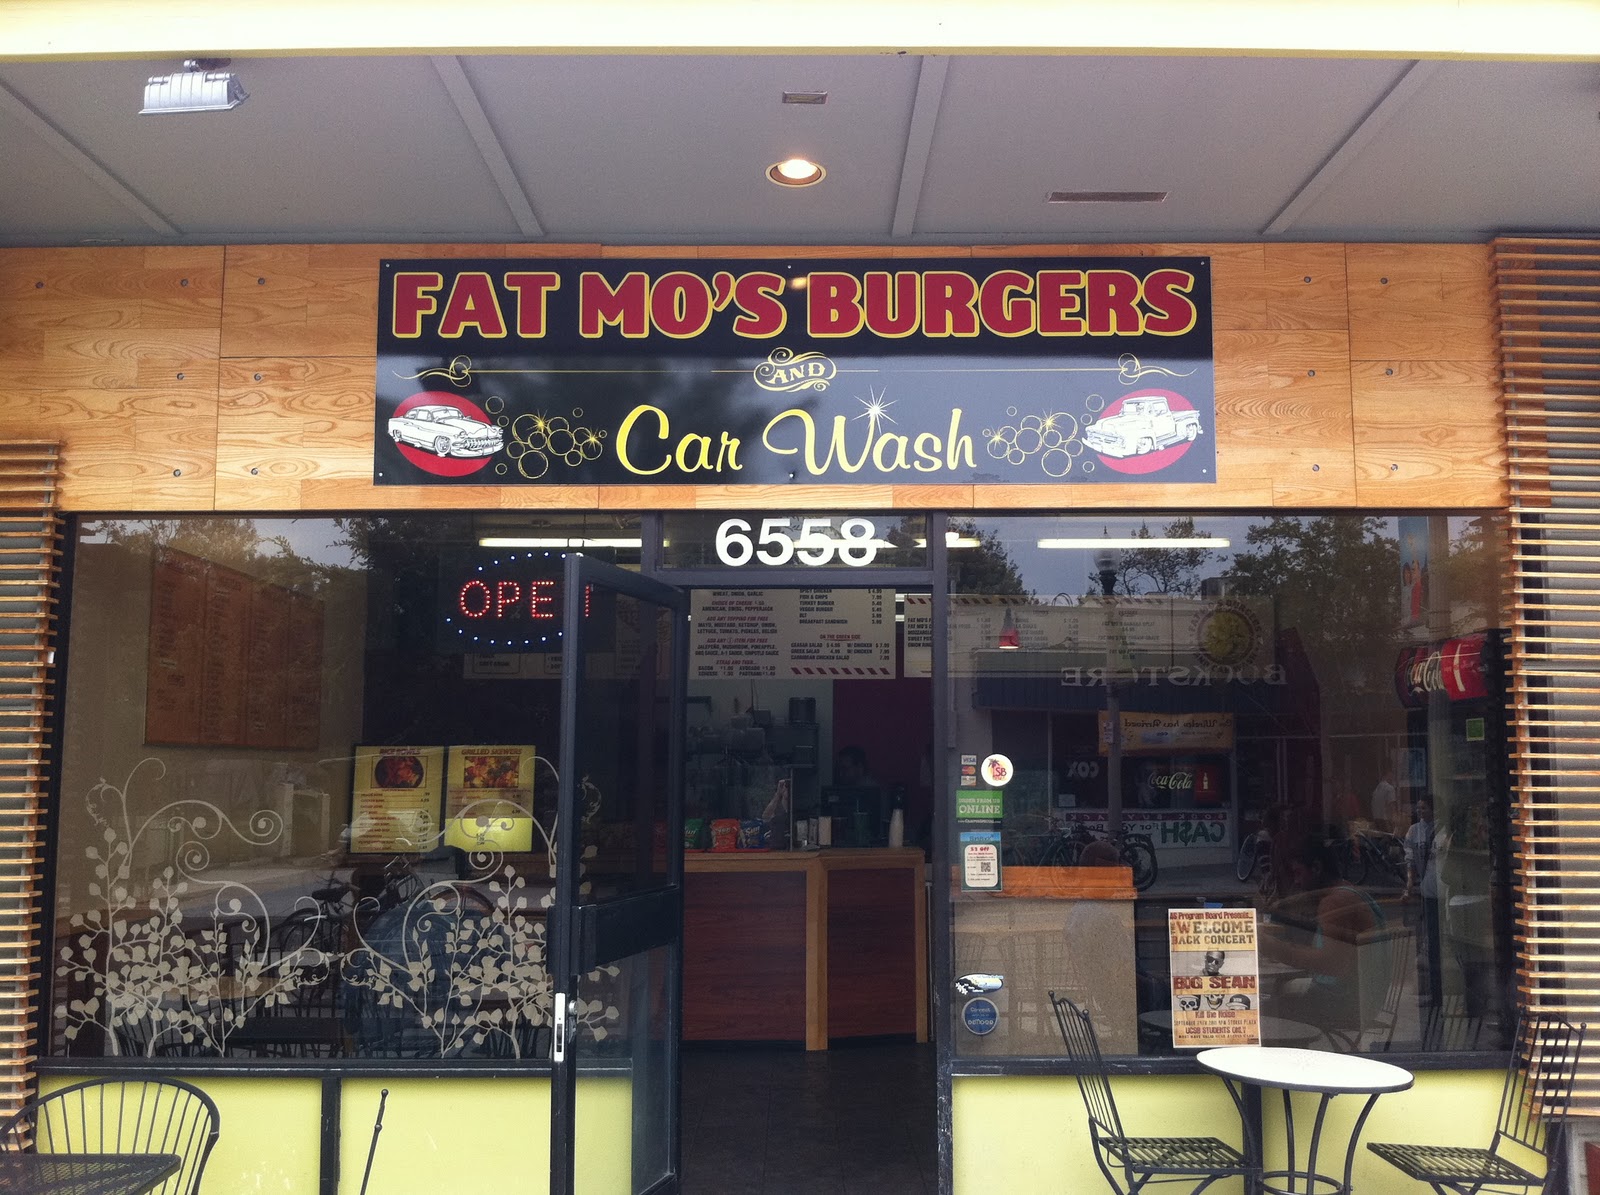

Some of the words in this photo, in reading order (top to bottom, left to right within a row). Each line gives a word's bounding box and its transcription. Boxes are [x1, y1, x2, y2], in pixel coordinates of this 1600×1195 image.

[392, 271, 561, 339] FAT
[578, 271, 786, 339] MO'S
[807, 270, 1198, 338] BURGERS
[768, 362, 826, 383] AND
[616, 405, 742, 475] Car
[763, 407, 977, 474] Wash
[715, 518, 878, 567] 6558
[959, 805, 1000, 814] ONLINE
[1179, 912, 1204, 920] Program
[1205, 912, 1222, 920] Board
[1176, 921, 1254, 933] WELCOME
[1171, 935, 1200, 945] BACK
[1204, 935, 1254, 945] CONCERT
[1174, 976, 1203, 989] BIG
[1209, 976, 1255, 989] SEAN
